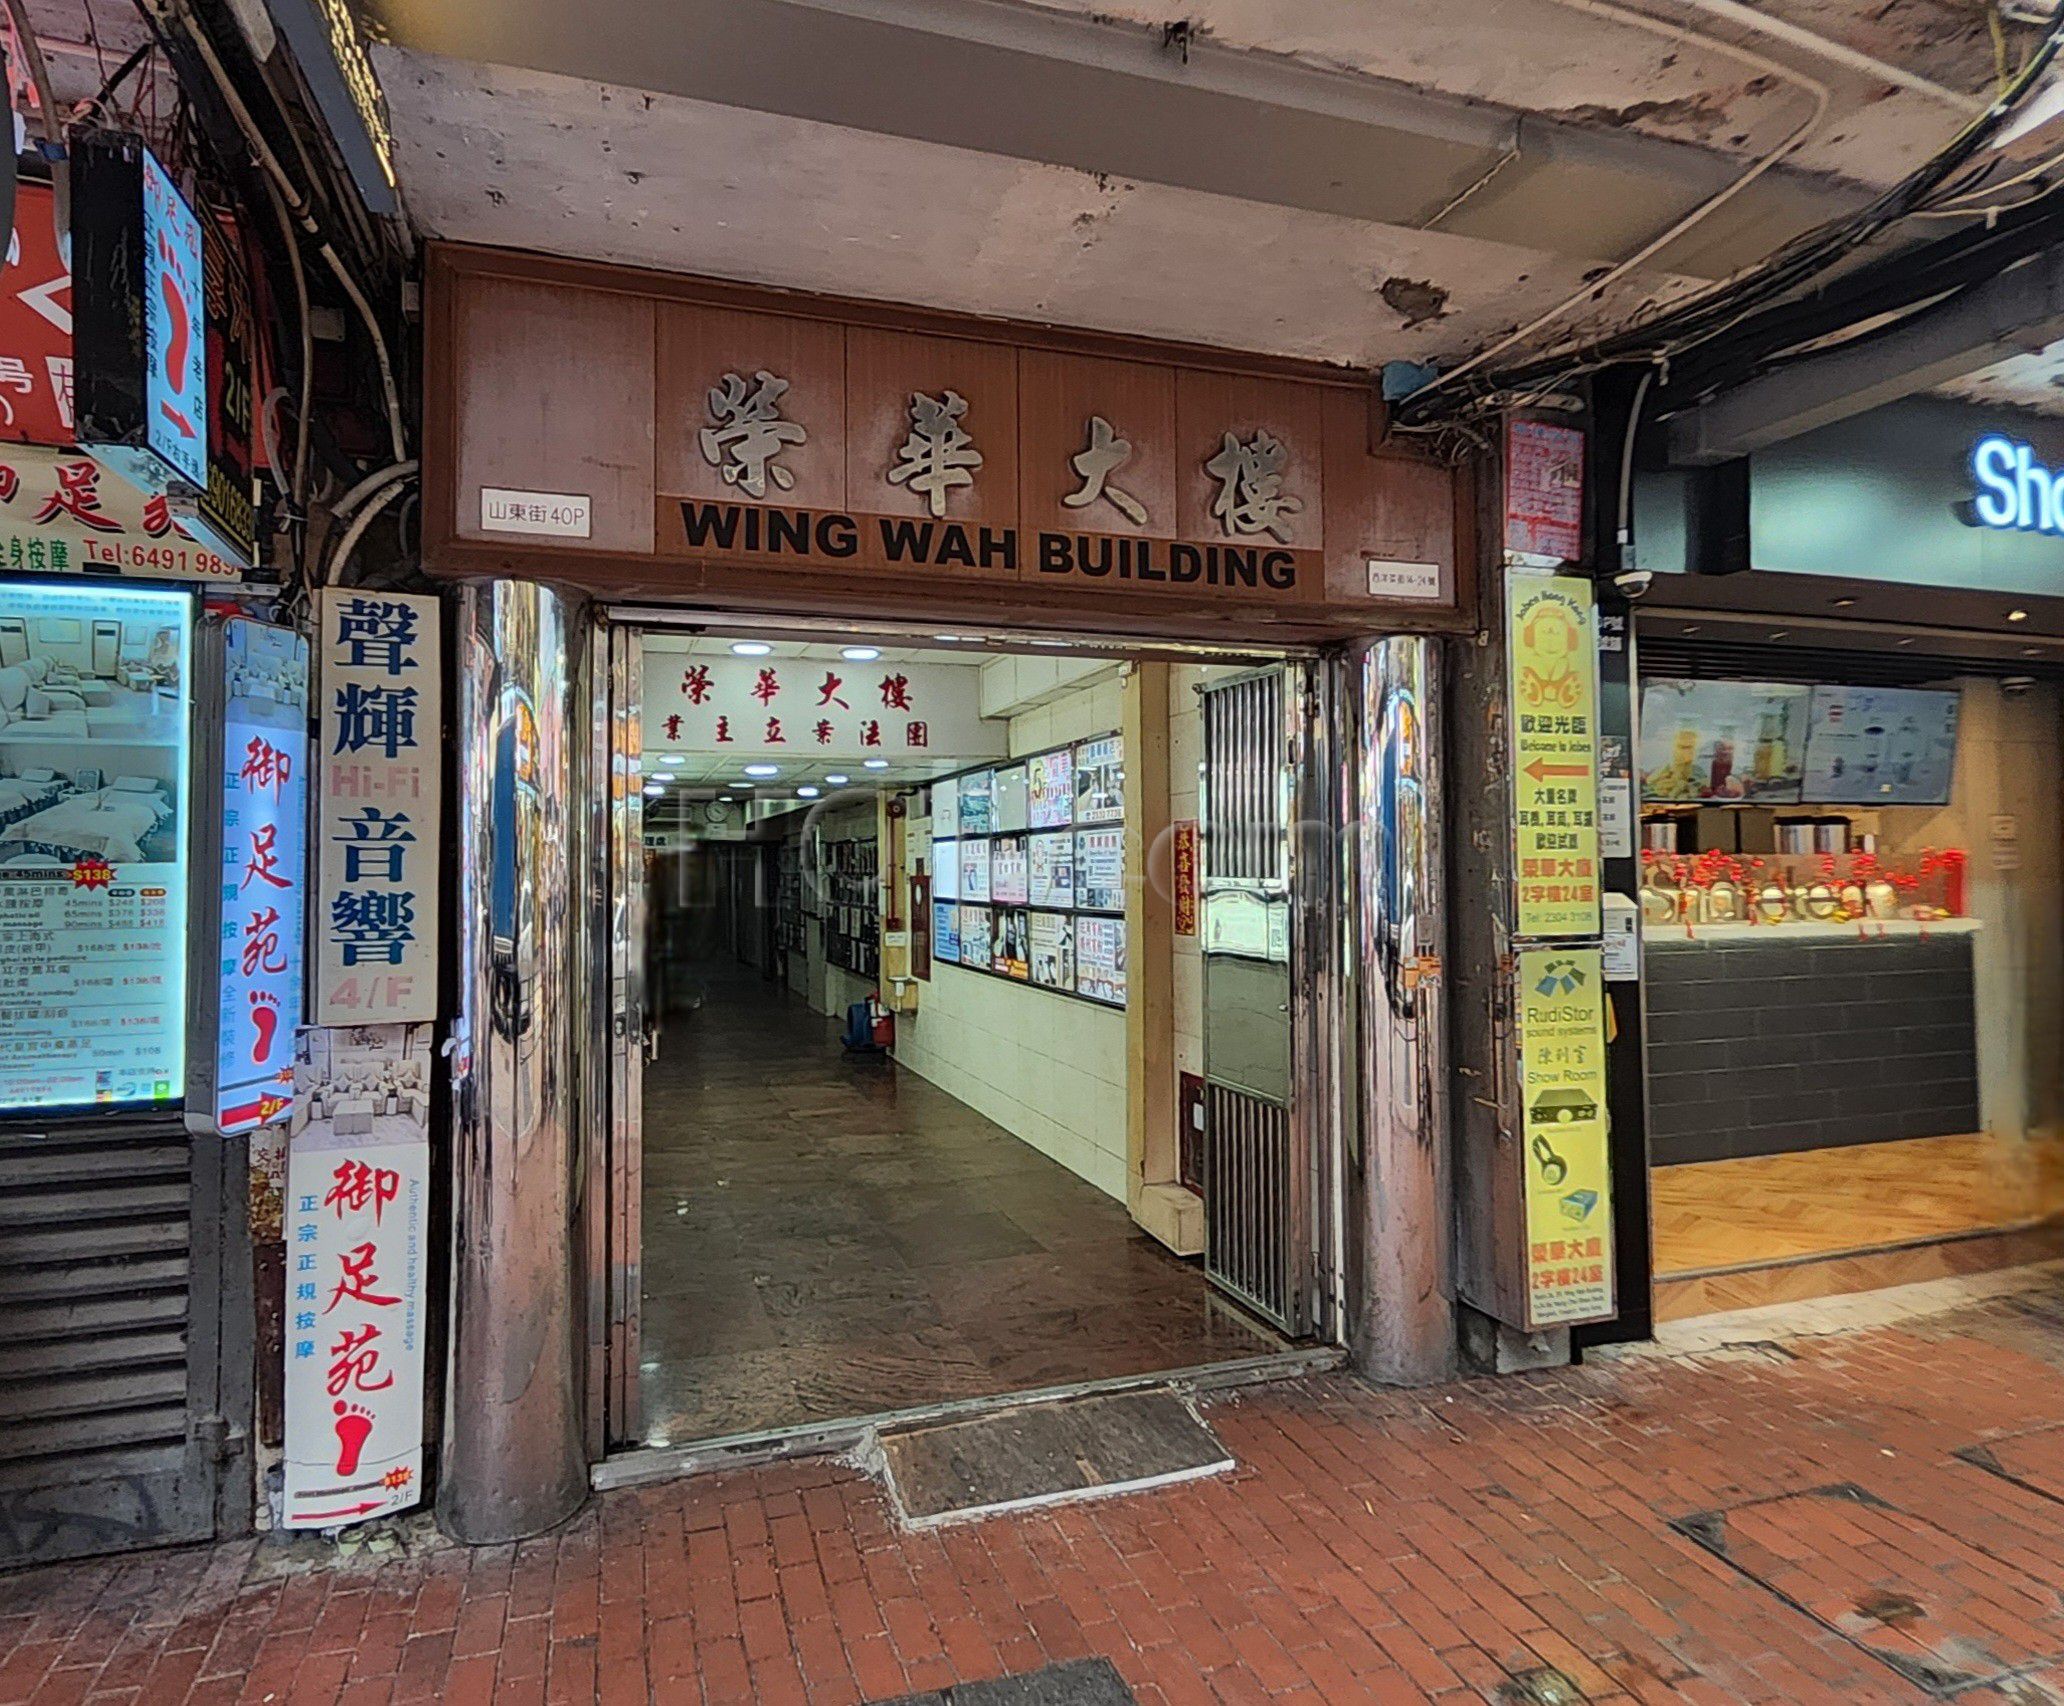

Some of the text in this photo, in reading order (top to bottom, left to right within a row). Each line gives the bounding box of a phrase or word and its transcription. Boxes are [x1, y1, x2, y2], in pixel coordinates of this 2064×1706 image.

[699, 370, 1303, 544] 榮華大樓
[488, 501, 586, 526] 山東街40P
[680, 502, 1296, 590] WING WAH BUILDING
[333, 598, 419, 759] 聲輝
[681, 664, 913, 712] 榮華大樓
[661, 714, 928, 747] 業主立案法團
[1520, 714, 1587, 735] 歡迎光臨
[332, 765, 420, 799] Hi-Fi
[240, 735, 294, 978] 御足苑
[73, 869, 111, 881] $138
[329, 807, 418, 967] 音響
[329, 977, 414, 1010] 4/F
[1527, 1005, 1594, 1023] RudiStor
[1527, 1028, 1555, 1038] sound
[1527, 1069, 1597, 1084] Show Room
[260, 1098, 285, 1117] 2/F
[294, 1194, 319, 1359] 正宗正規按摩
[323, 1156, 403, 1397] 御足苑
[402, 1178, 420, 1352] Authentic and healthy massage
[391, 1489, 413, 1506] 2/F
